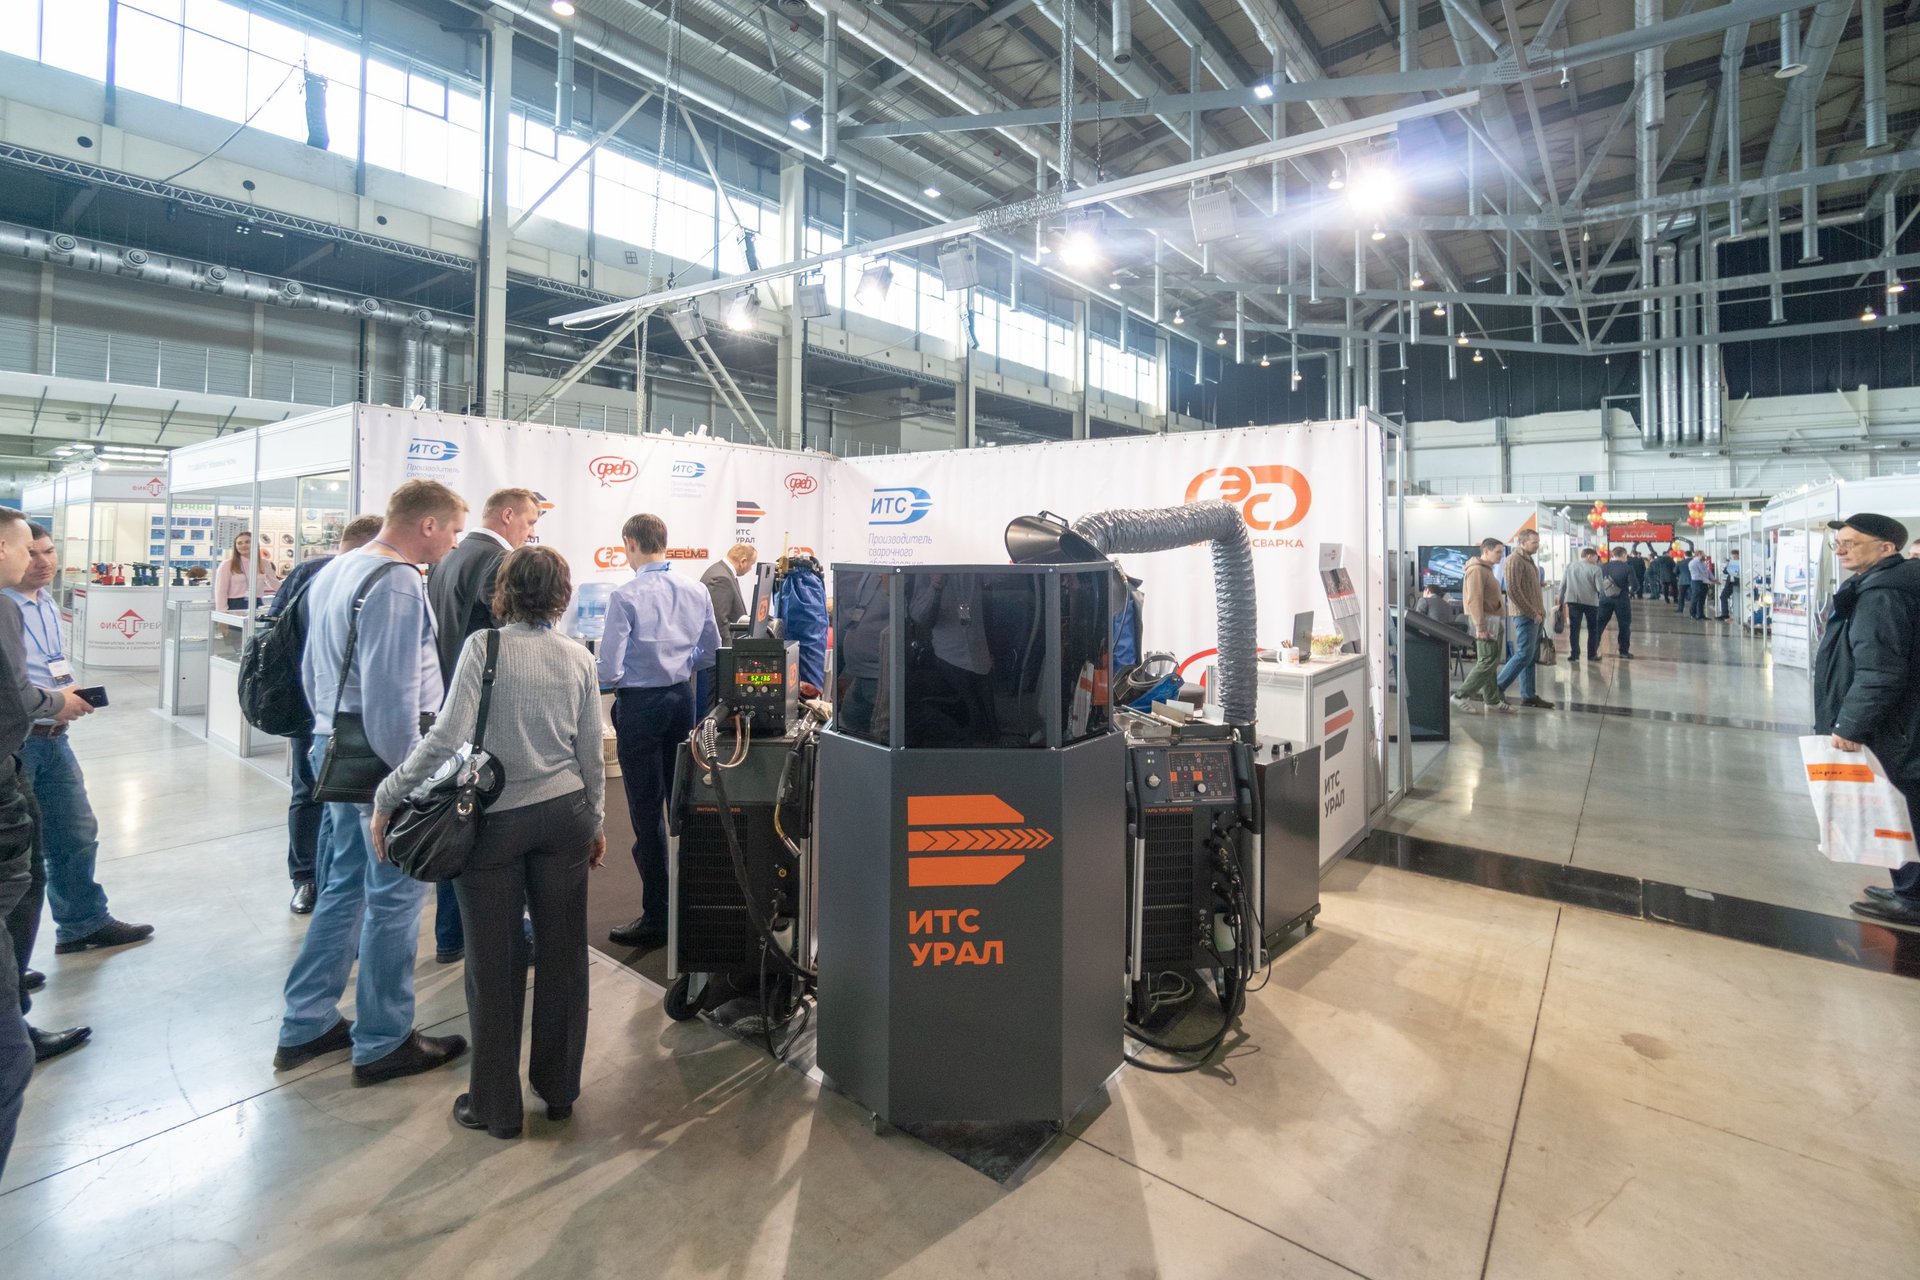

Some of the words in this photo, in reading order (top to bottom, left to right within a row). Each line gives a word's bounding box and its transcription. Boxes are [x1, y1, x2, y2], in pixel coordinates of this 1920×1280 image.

[408, 443, 440, 455] ИТС
[672, 464, 694, 474] ИТС
[870, 496, 907, 514] ИТС
[868, 532, 933, 546] Производитель
[868, 548, 914, 558] сварочного
[100, 622, 123, 630] ФИКС
[1324, 770, 1340, 795] ИТС
[1324, 788, 1345, 818] УРАЛ
[908, 908, 981, 935] ИТС
[908, 940, 1004, 967] УРАЛ
